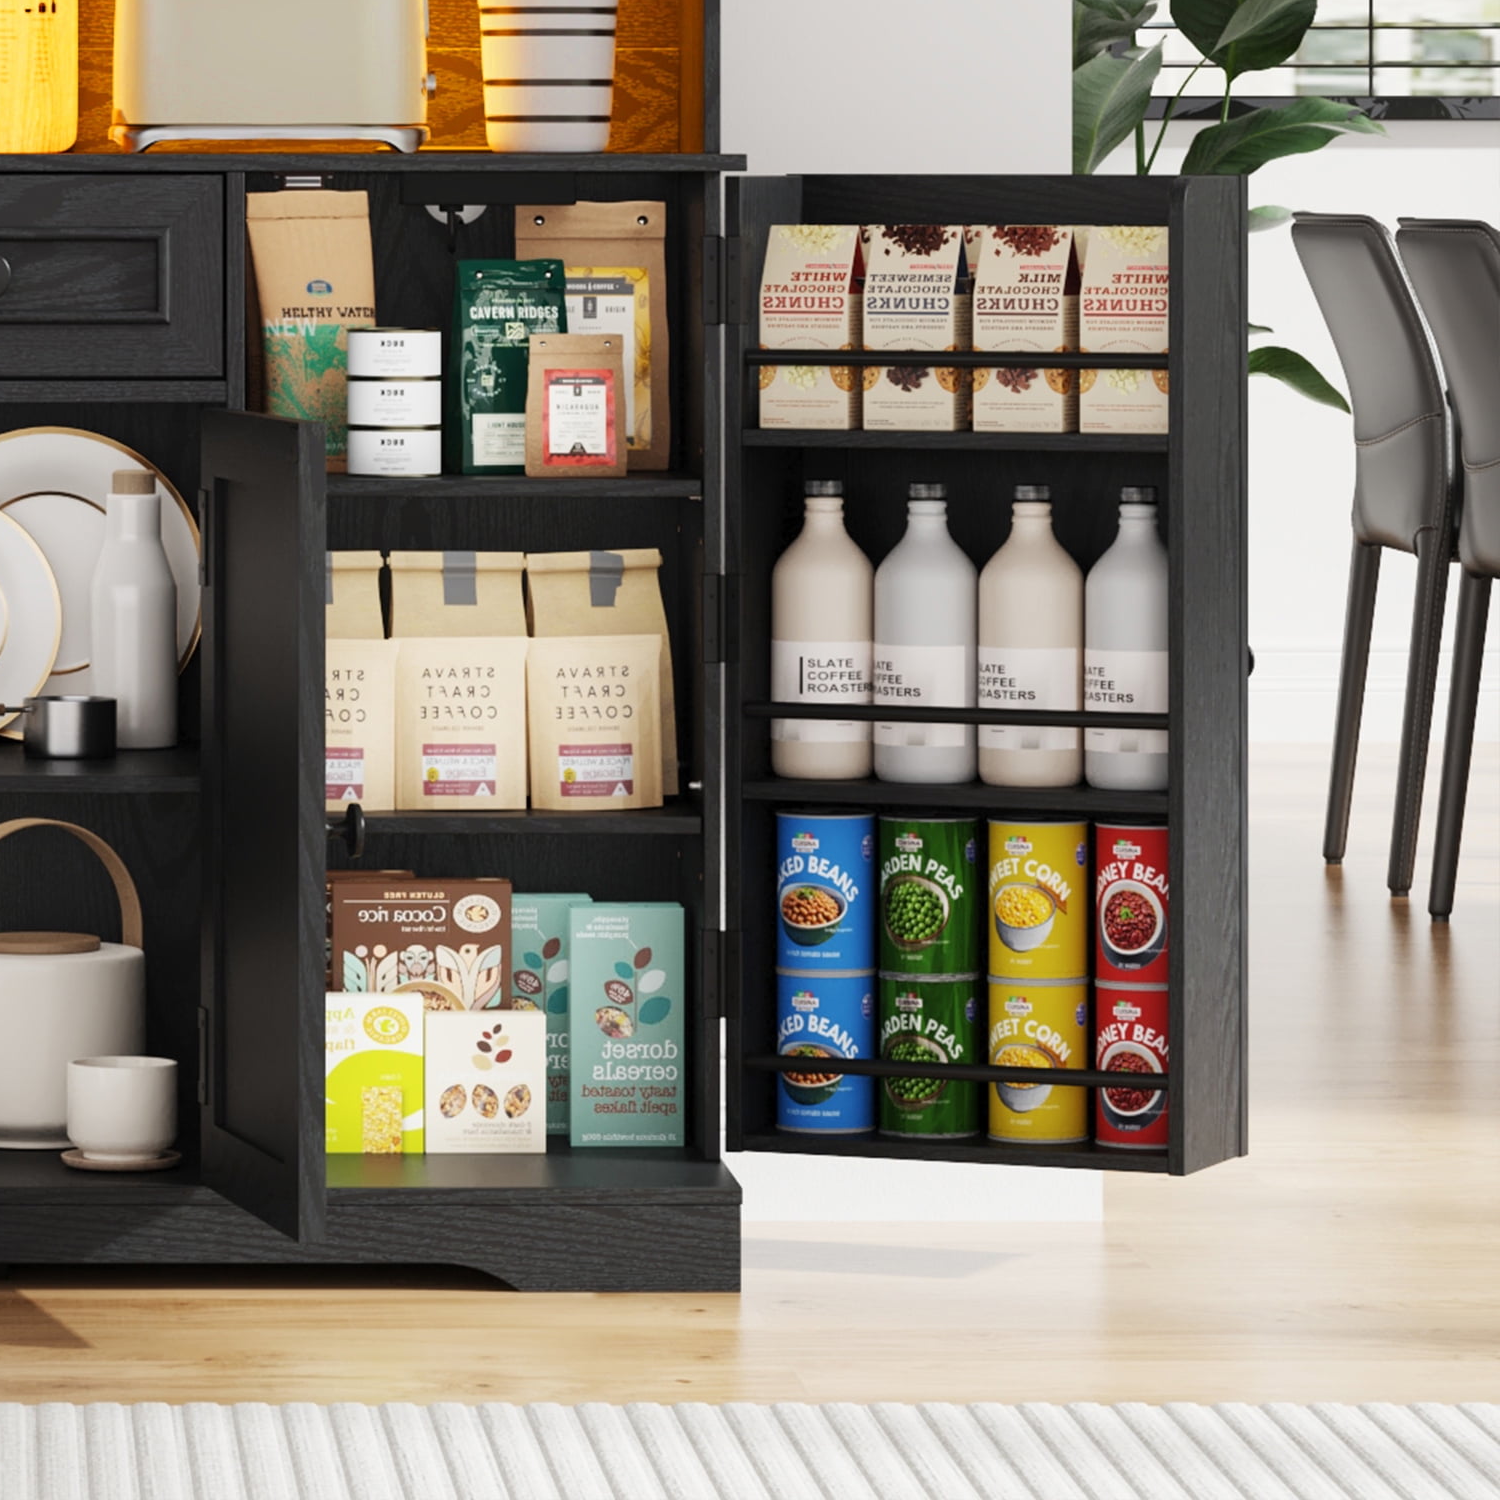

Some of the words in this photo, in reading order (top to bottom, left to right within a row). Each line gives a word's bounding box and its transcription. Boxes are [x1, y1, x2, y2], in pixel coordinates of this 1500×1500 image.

[264, 317, 318, 337] NEW
[282, 307, 333, 318] HELTHY
[469, 306, 515, 320] CAVERN
[518, 306, 559, 320] RIDGES
[807, 658, 854, 669] SLATE
[807, 671, 863, 681] COFFEE
[808, 855, 859, 903] BEANS
[881, 854, 922, 888] ARDEN
[925, 858, 964, 900] PEAS
[1024, 859, 1072, 902] CORN
[1132, 862, 1169, 899] BEA
[808, 1013, 859, 1059] BEANS
[881, 1013, 922, 1045] ARDEN
[925, 1017, 964, 1060] PEAS
[1024, 1019, 1072, 1062] CORN
[1132, 1023, 1169, 1060] BEA
